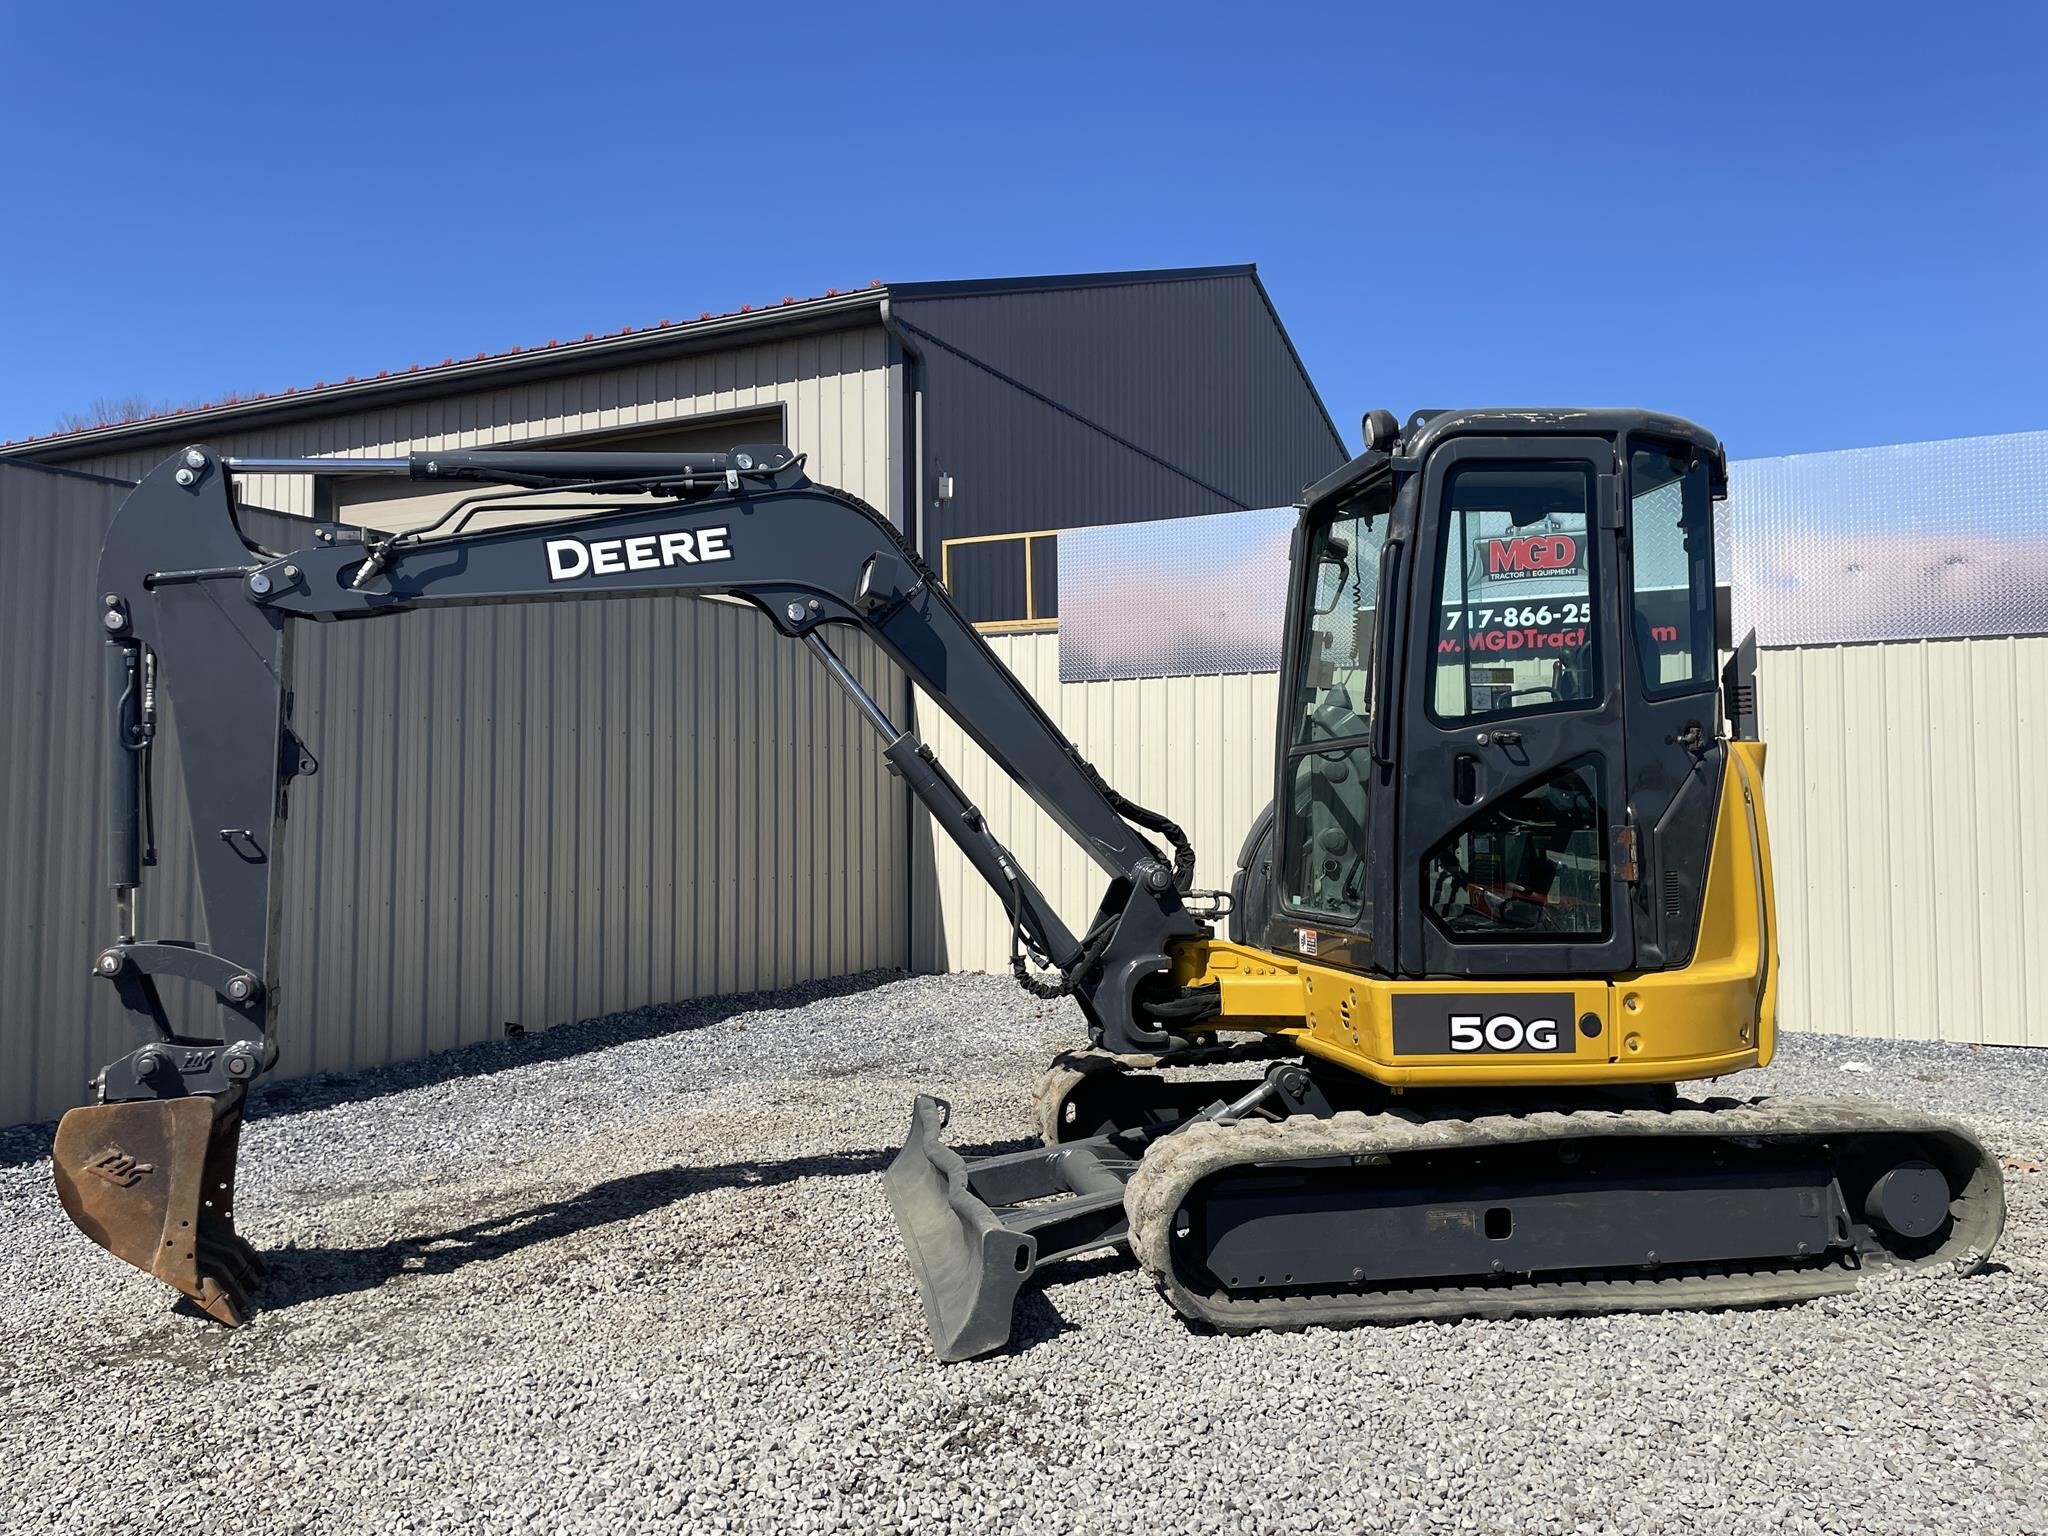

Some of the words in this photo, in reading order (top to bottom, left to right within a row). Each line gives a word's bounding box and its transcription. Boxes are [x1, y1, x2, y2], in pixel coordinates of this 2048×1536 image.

[546, 527, 731, 580] DEERE
[1489, 536, 1576, 573] MGD
[1490, 571, 1525, 580] TRACTOR
[1532, 568, 1576, 577] EQUIPMENT
[1451, 1015, 1557, 1050] 50G
